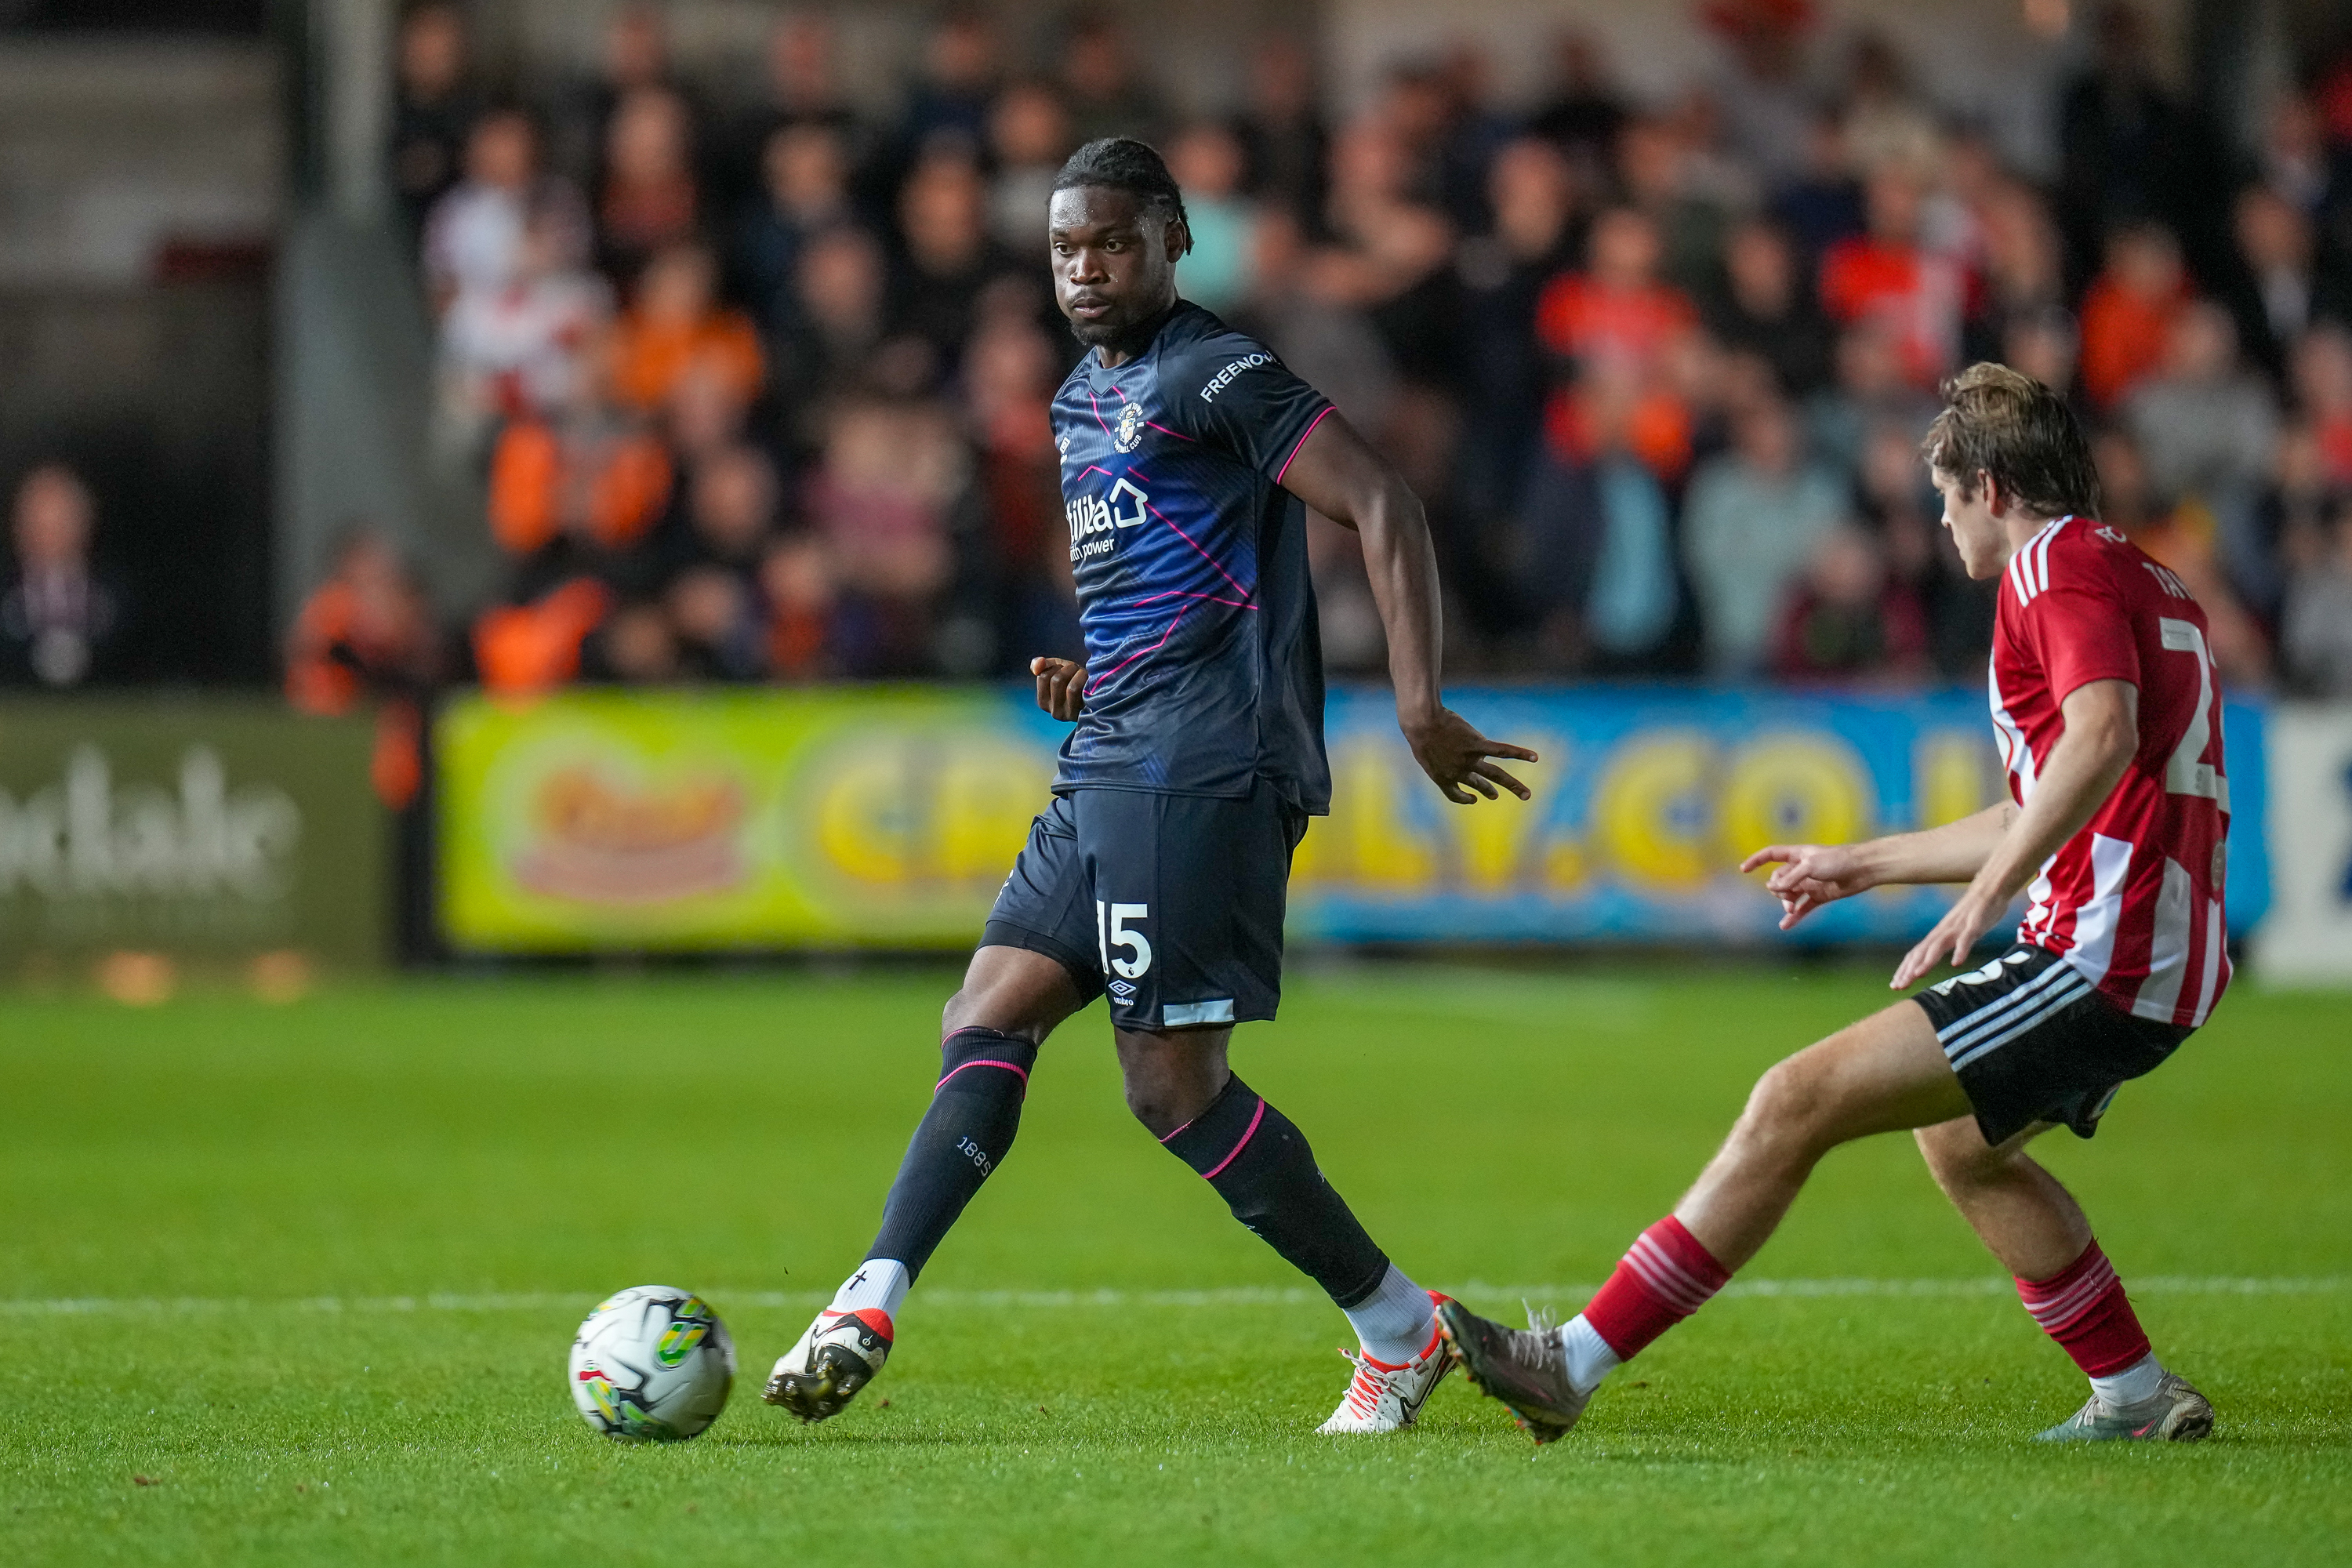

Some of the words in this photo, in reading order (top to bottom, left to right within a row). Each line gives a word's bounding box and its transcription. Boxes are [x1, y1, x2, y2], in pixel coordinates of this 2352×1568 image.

[1130, 434, 1142, 450] CLUB
[1066, 494, 1114, 544] tilita
[1070, 540, 1083, 563] ith
[1082, 538, 1116, 561] power
[0, 745, 302, 898] dale
[1096, 899, 1152, 979] 15
[956, 1137, 992, 1177] 1885
